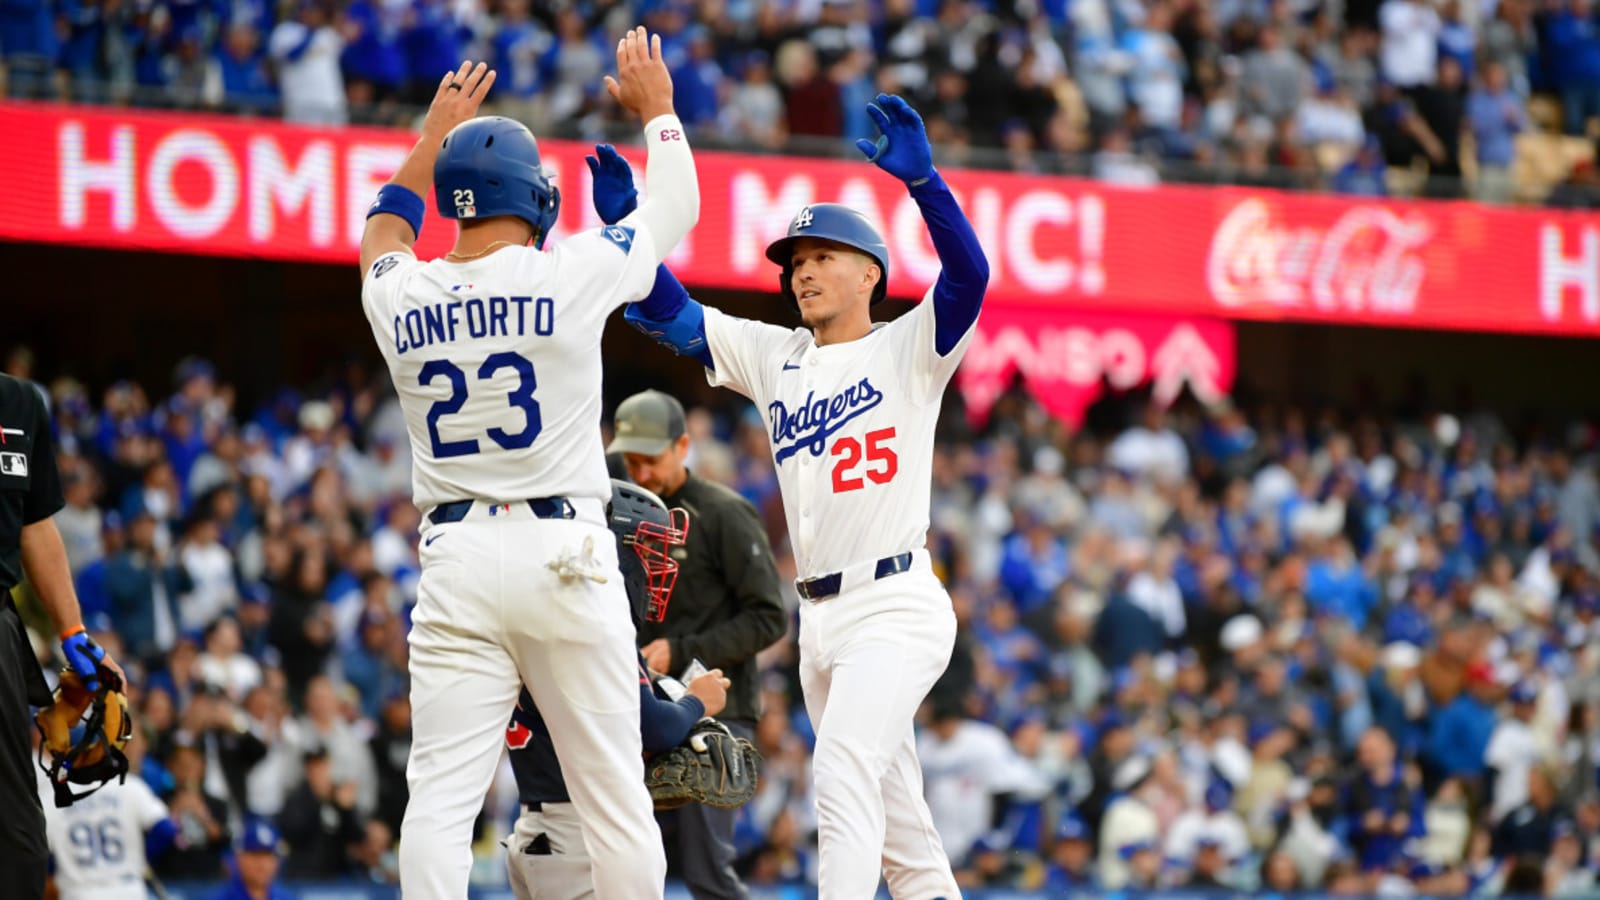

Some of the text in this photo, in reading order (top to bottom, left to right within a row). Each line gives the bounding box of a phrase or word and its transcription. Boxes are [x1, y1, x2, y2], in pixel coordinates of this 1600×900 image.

[453, 189, 475, 206] 23
[394, 296, 554, 354] CONFORTO
[417, 351, 543, 459] 23
[768, 377, 883, 467] Dodgers
[830, 426, 898, 494] 25
[68, 817, 126, 869] 96
